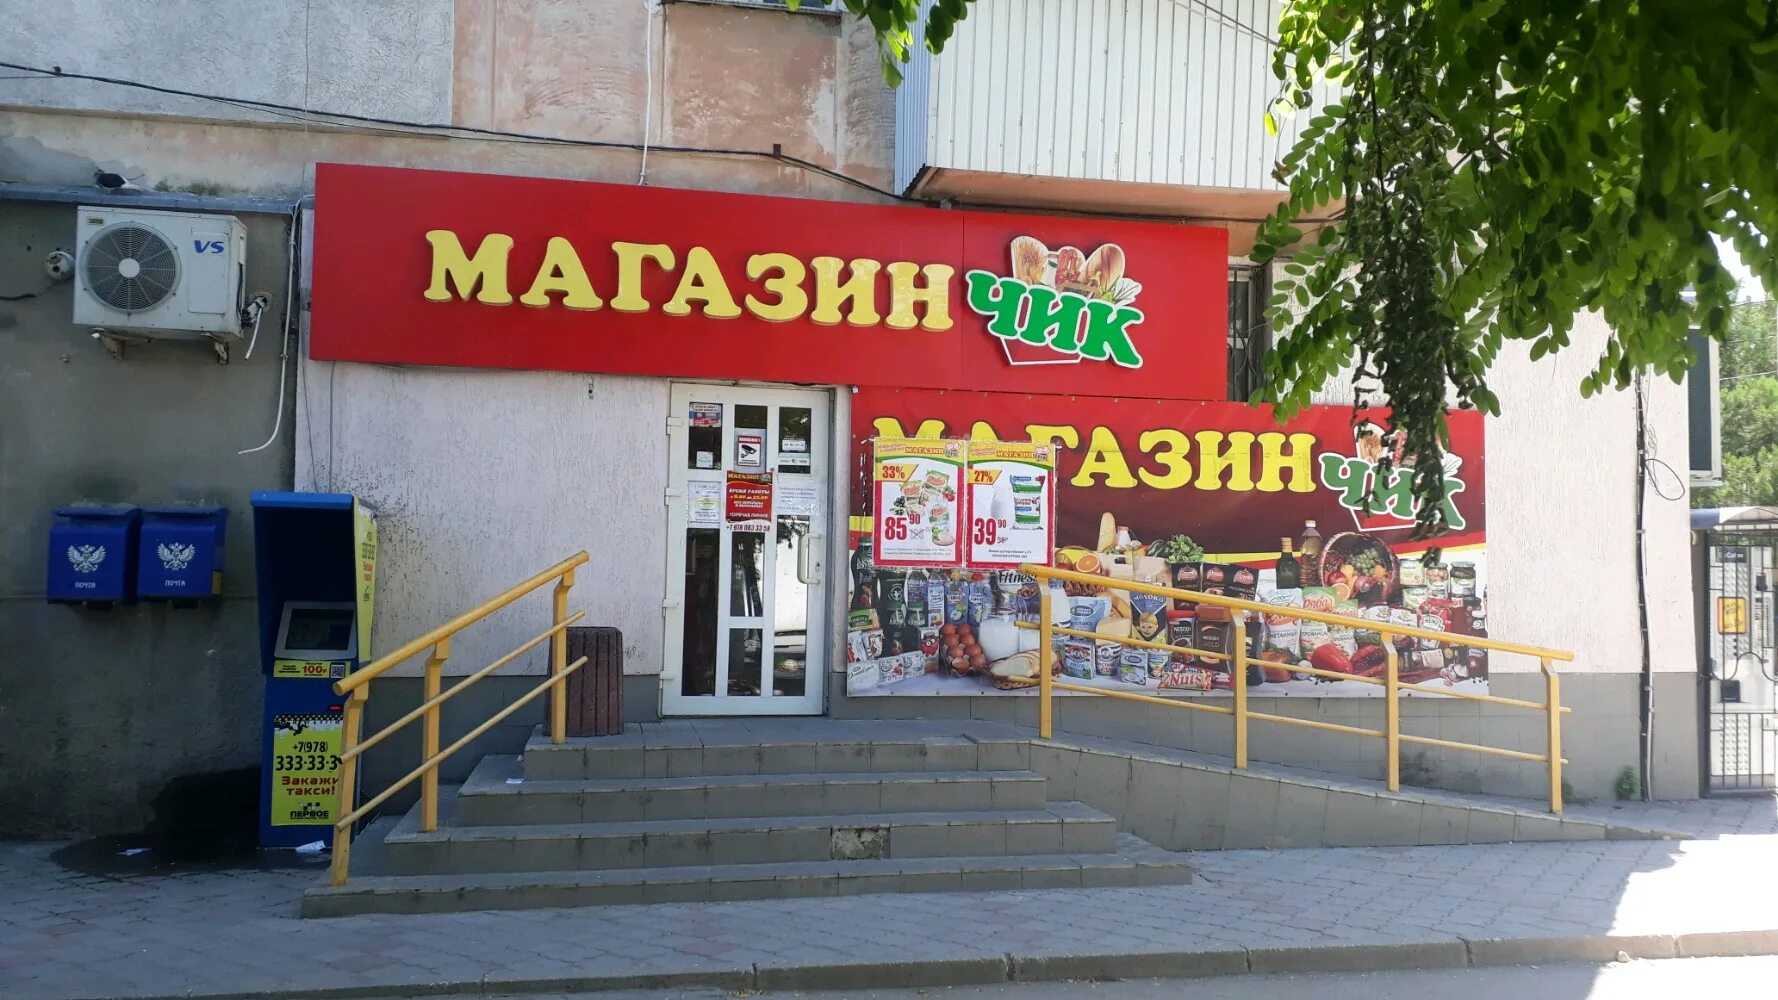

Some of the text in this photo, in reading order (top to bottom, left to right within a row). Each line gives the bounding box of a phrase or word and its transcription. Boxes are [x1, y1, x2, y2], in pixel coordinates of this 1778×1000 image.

[194, 239, 224, 253] VS
[424, 230, 1143, 367] МАГАЗИН ЧИК
[882, 465, 905, 479] 33%
[974, 470, 993, 483] 27%
[885, 517, 907, 540] 85
[909, 513, 920, 525] 90
[974, 518, 1007, 545] 39 90
[293, 741, 327, 753] +7(978)
[282, 776, 338, 785] Закажи
[286, 786, 335, 795] такси!
